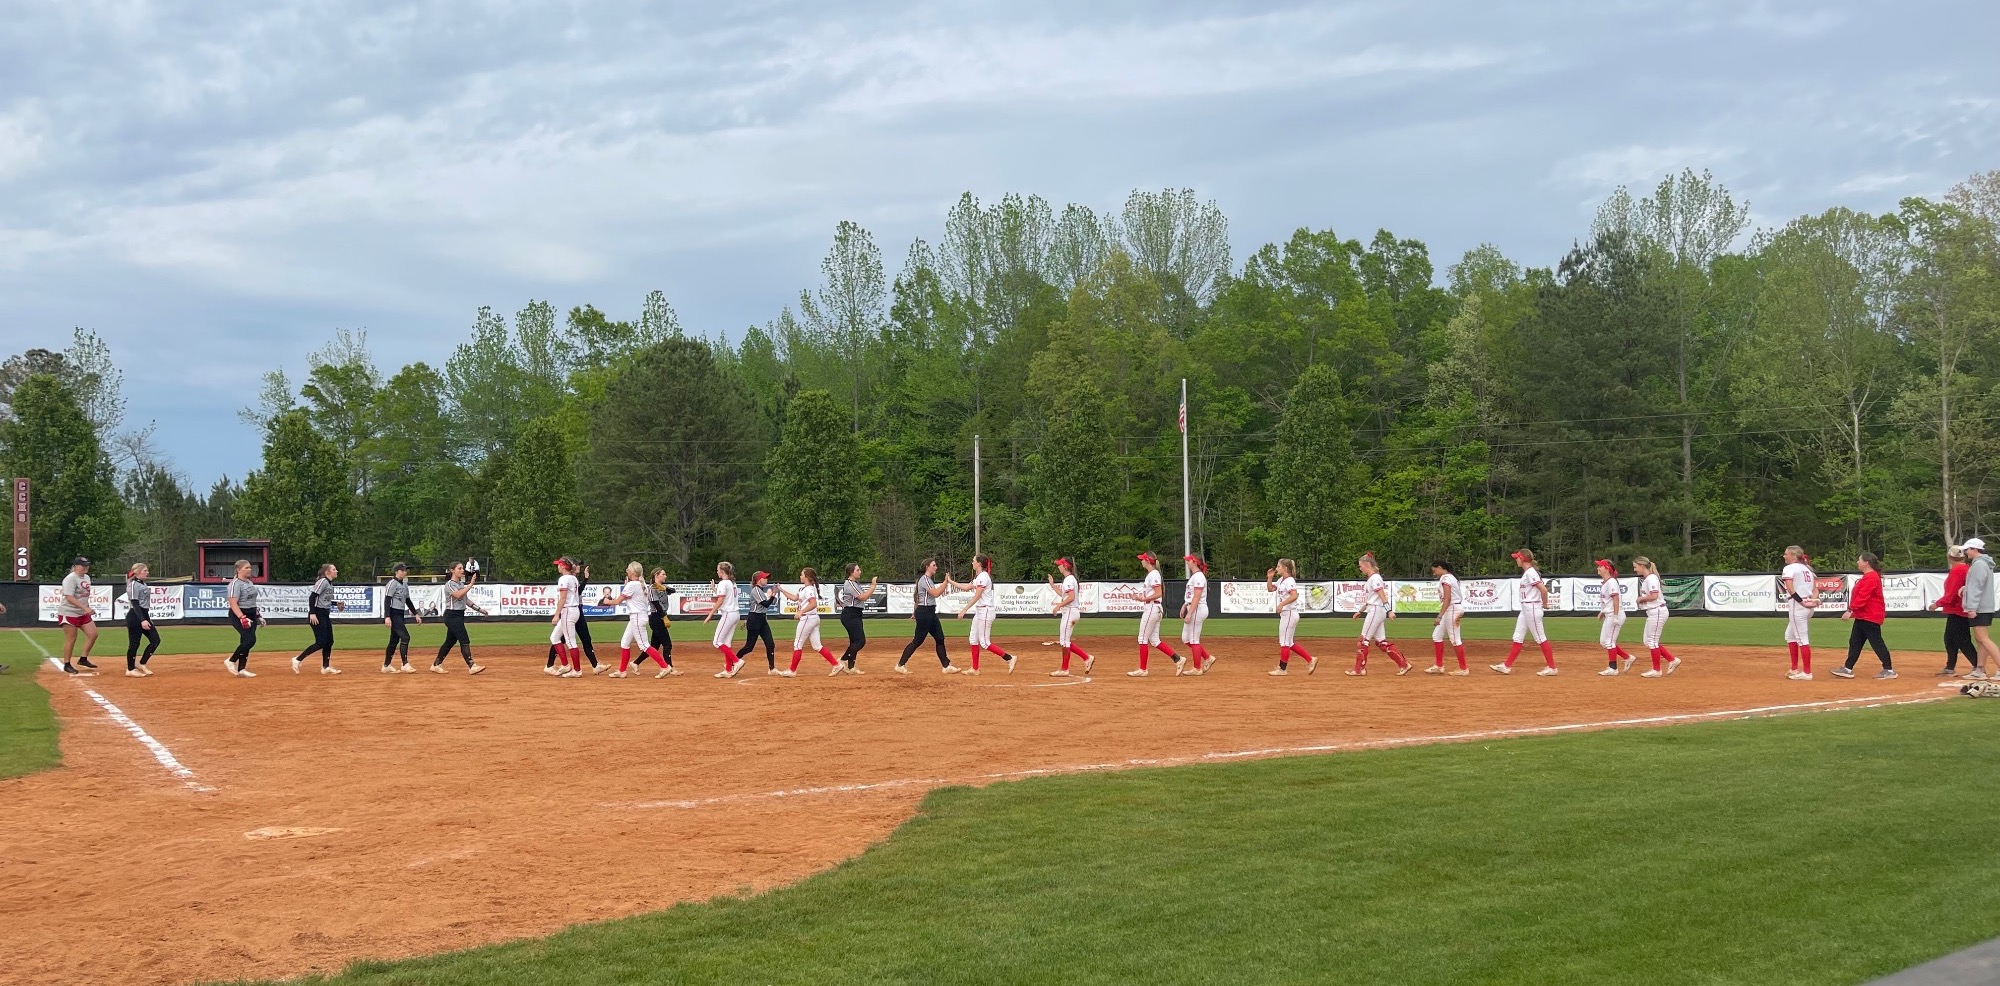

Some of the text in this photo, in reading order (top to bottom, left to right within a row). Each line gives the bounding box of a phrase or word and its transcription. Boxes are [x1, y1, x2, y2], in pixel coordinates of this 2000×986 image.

[17, 547, 28, 577] 200
[1803, 570, 1812, 582] 16
[510, 586, 546, 595] JIFFY
[1741, 590, 1772, 598] County
[189, 596, 231, 608] FirstBa
[501, 597, 556, 606] BURGER
